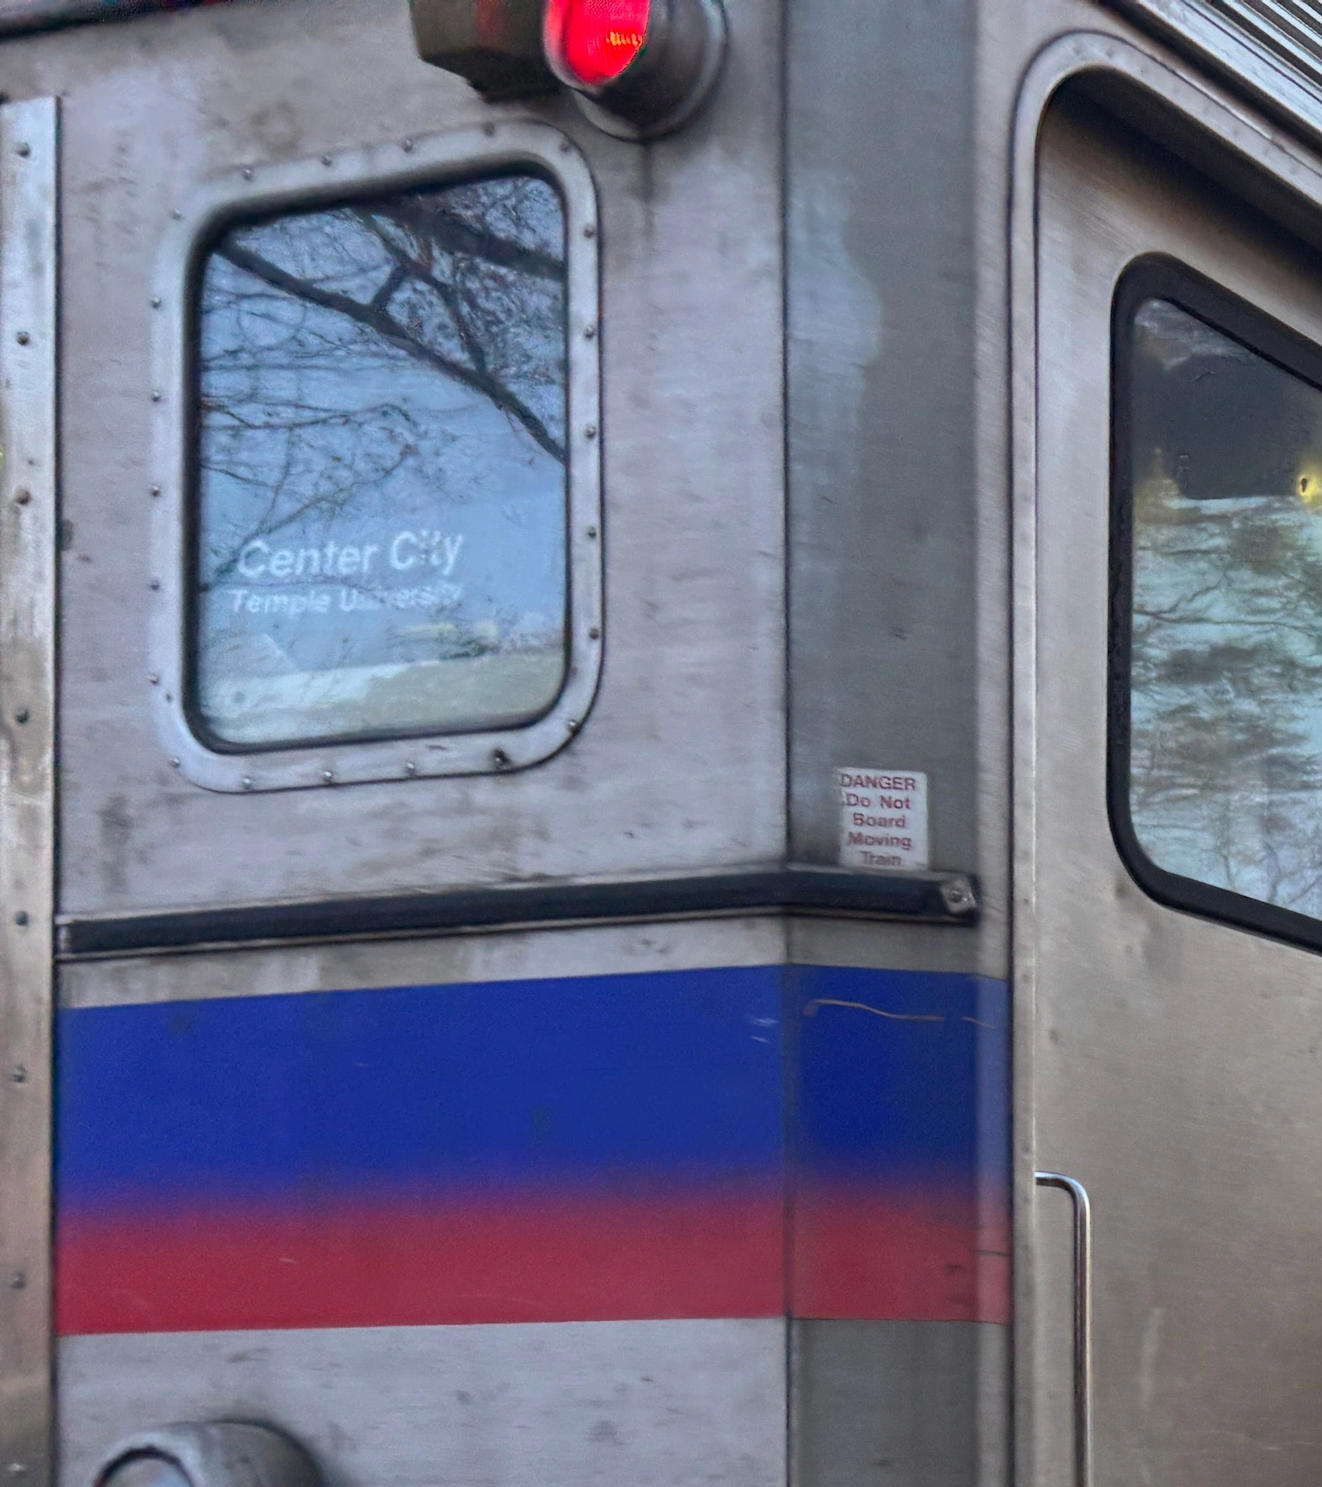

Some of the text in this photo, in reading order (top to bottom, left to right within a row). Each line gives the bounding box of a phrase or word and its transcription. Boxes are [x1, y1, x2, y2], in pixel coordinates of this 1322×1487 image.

[237, 529, 464, 578] Center City
[230, 588, 332, 615] Temple
[839, 774, 918, 791] DANGER
[846, 793, 912, 810] Do Not
[852, 813, 907, 828] Board
[848, 831, 913, 851] Moving
[860, 851, 903, 866] Train
